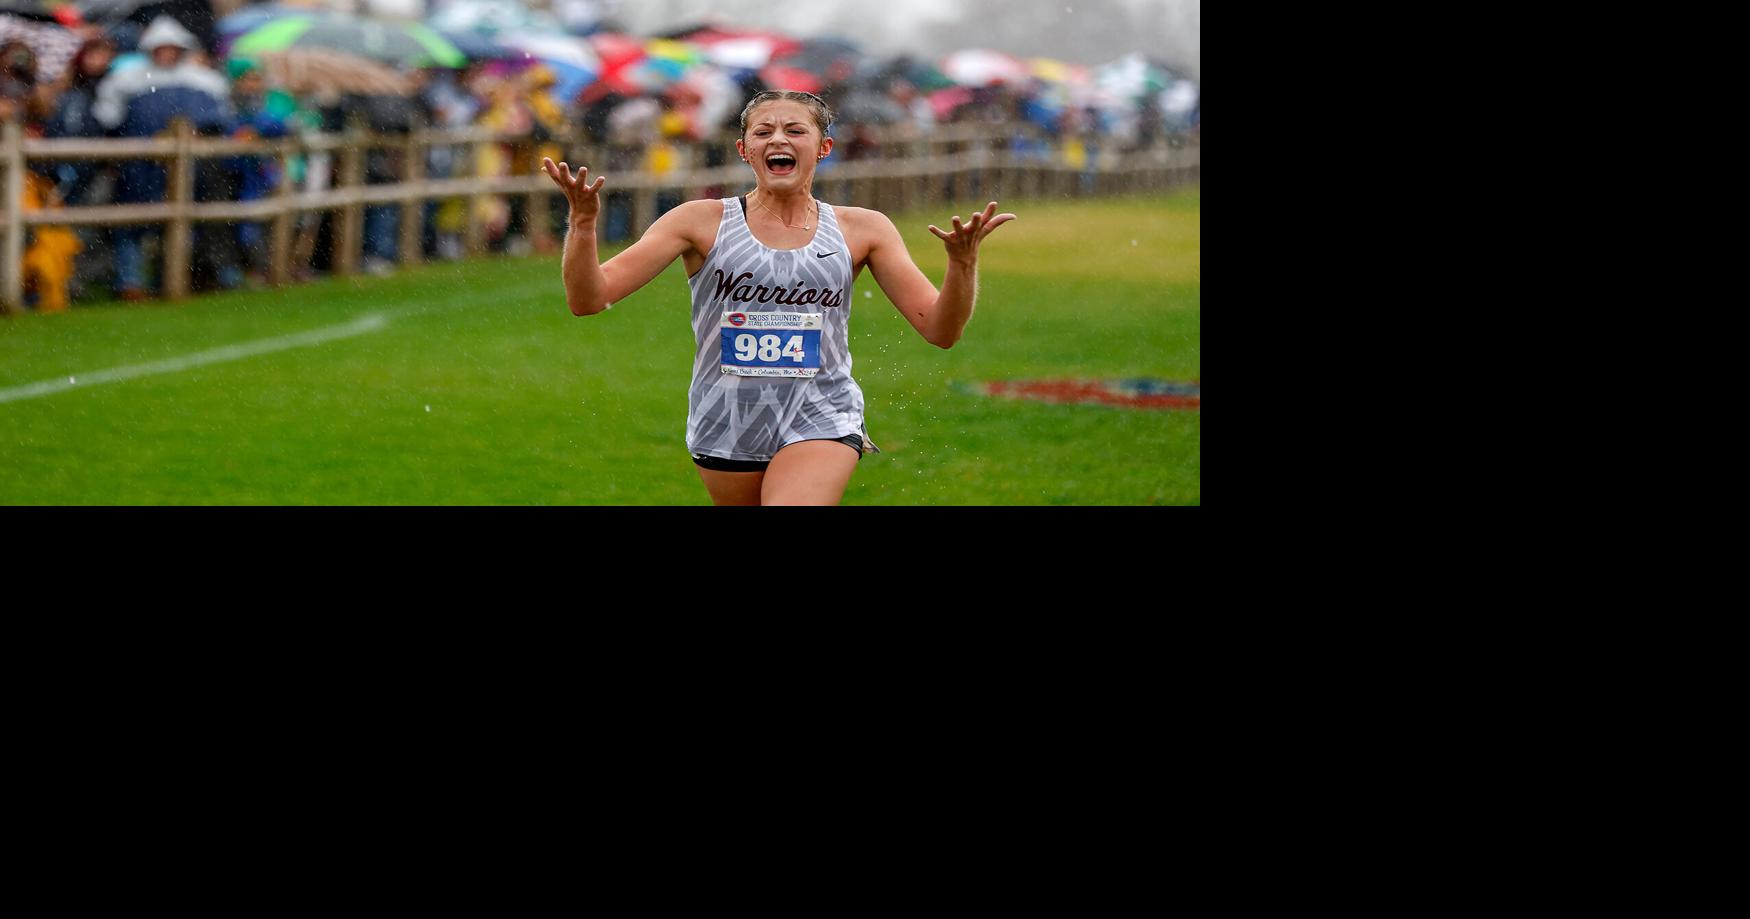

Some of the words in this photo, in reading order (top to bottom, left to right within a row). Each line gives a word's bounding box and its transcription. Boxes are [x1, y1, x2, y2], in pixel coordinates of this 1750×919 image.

[713, 269, 843, 308] Warriors
[770, 314, 802, 322] COUNTRY
[734, 333, 805, 362] 984
